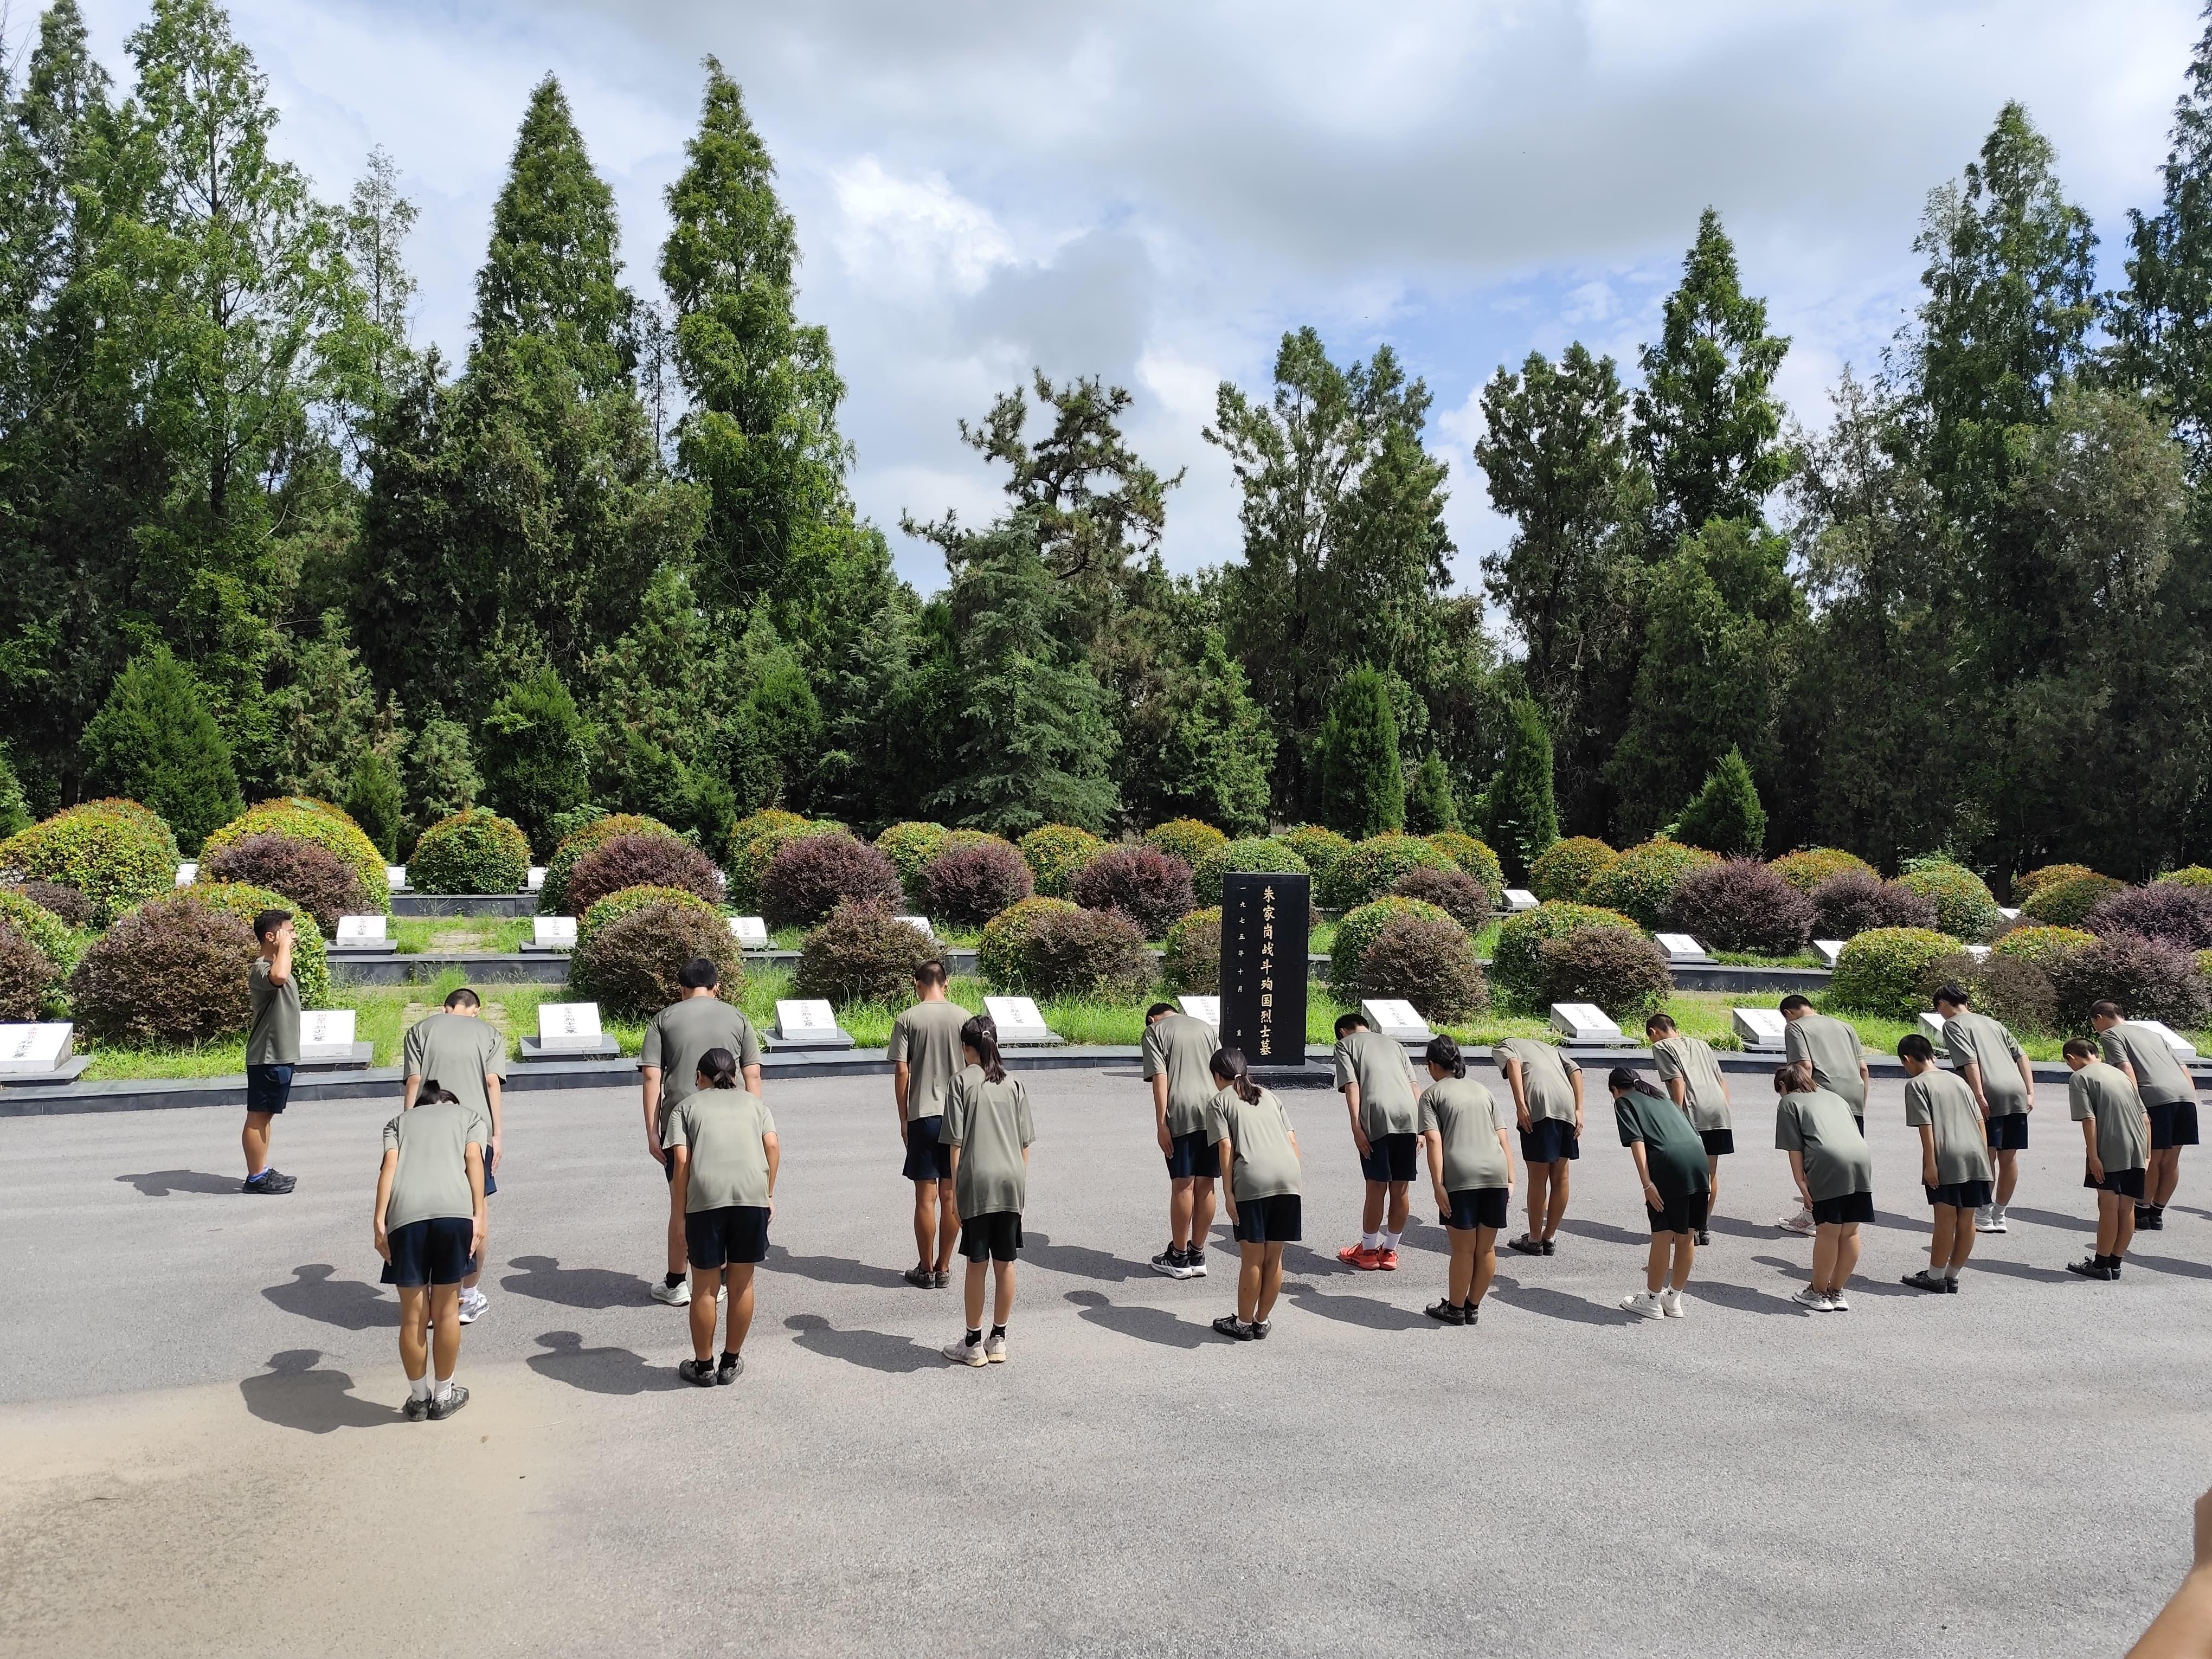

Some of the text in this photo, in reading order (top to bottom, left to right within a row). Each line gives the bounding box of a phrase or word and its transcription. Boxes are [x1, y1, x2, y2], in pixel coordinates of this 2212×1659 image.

[1238, 888, 1246, 992] 一九七五年十月
[1260, 886, 1275, 1055] 朱家岗战斗殉国烈士墓
